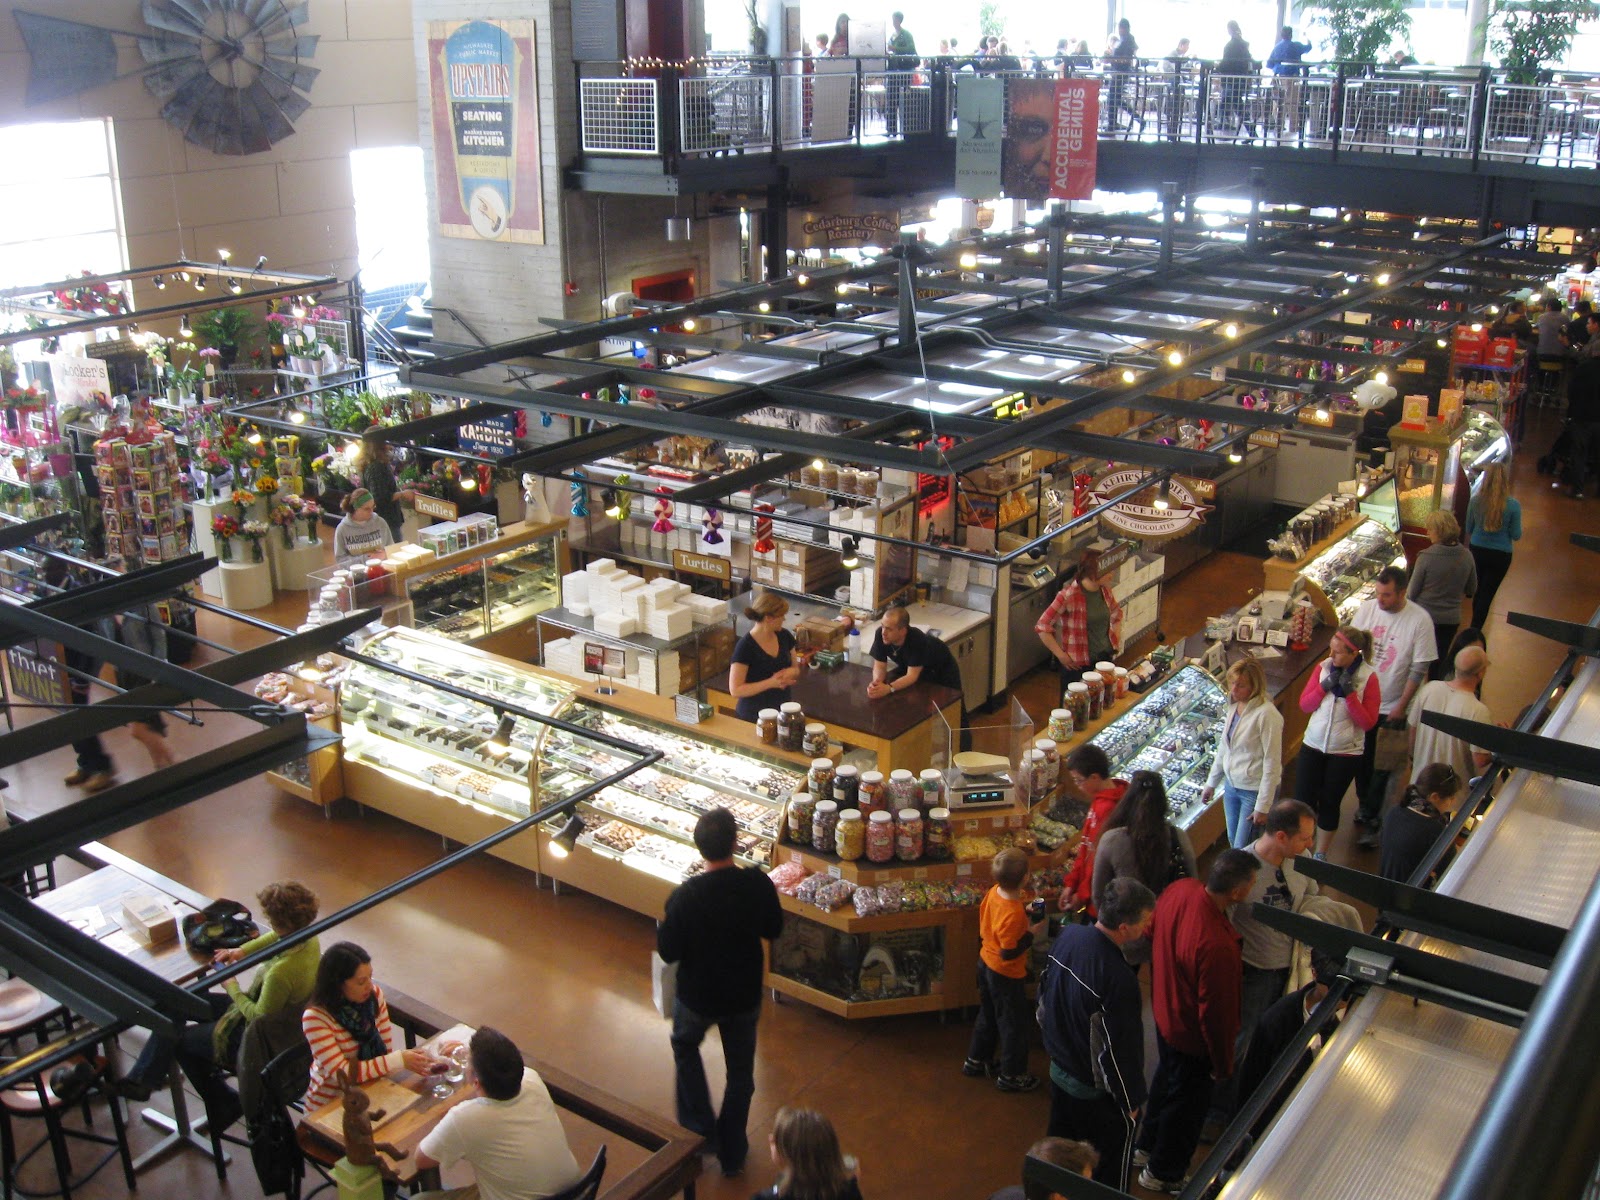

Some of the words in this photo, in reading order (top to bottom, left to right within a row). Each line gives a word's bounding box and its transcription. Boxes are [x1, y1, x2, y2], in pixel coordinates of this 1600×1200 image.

[450, 64, 510, 97] UPSTAIRS
[462, 110, 503, 121] SEATING
[1070, 87, 1085, 151] GENIUS
[463, 135, 504, 146] KITCHEN
[1055, 88, 1072, 189] ACCIDENTAL
[804, 216, 860, 234] Cedarburg
[863, 216, 897, 232] Coffee
[828, 229, 873, 240] Roastery
[486, 419, 504, 428] MADE
[459, 423, 513, 447] KANDIES
[490, 446, 504, 454] 1930
[1102, 472, 1141, 490] KEHR'S
[417, 498, 454, 518] Truffles
[1115, 502, 1147, 515] SINCE
[1112, 514, 1129, 526] FINE
[1129, 522, 1175, 532] CHOCOLATES
[345, 529, 382, 545] MARQUETTE
[680, 554, 723, 574] Turtles
[11, 664, 64, 705] WINE
